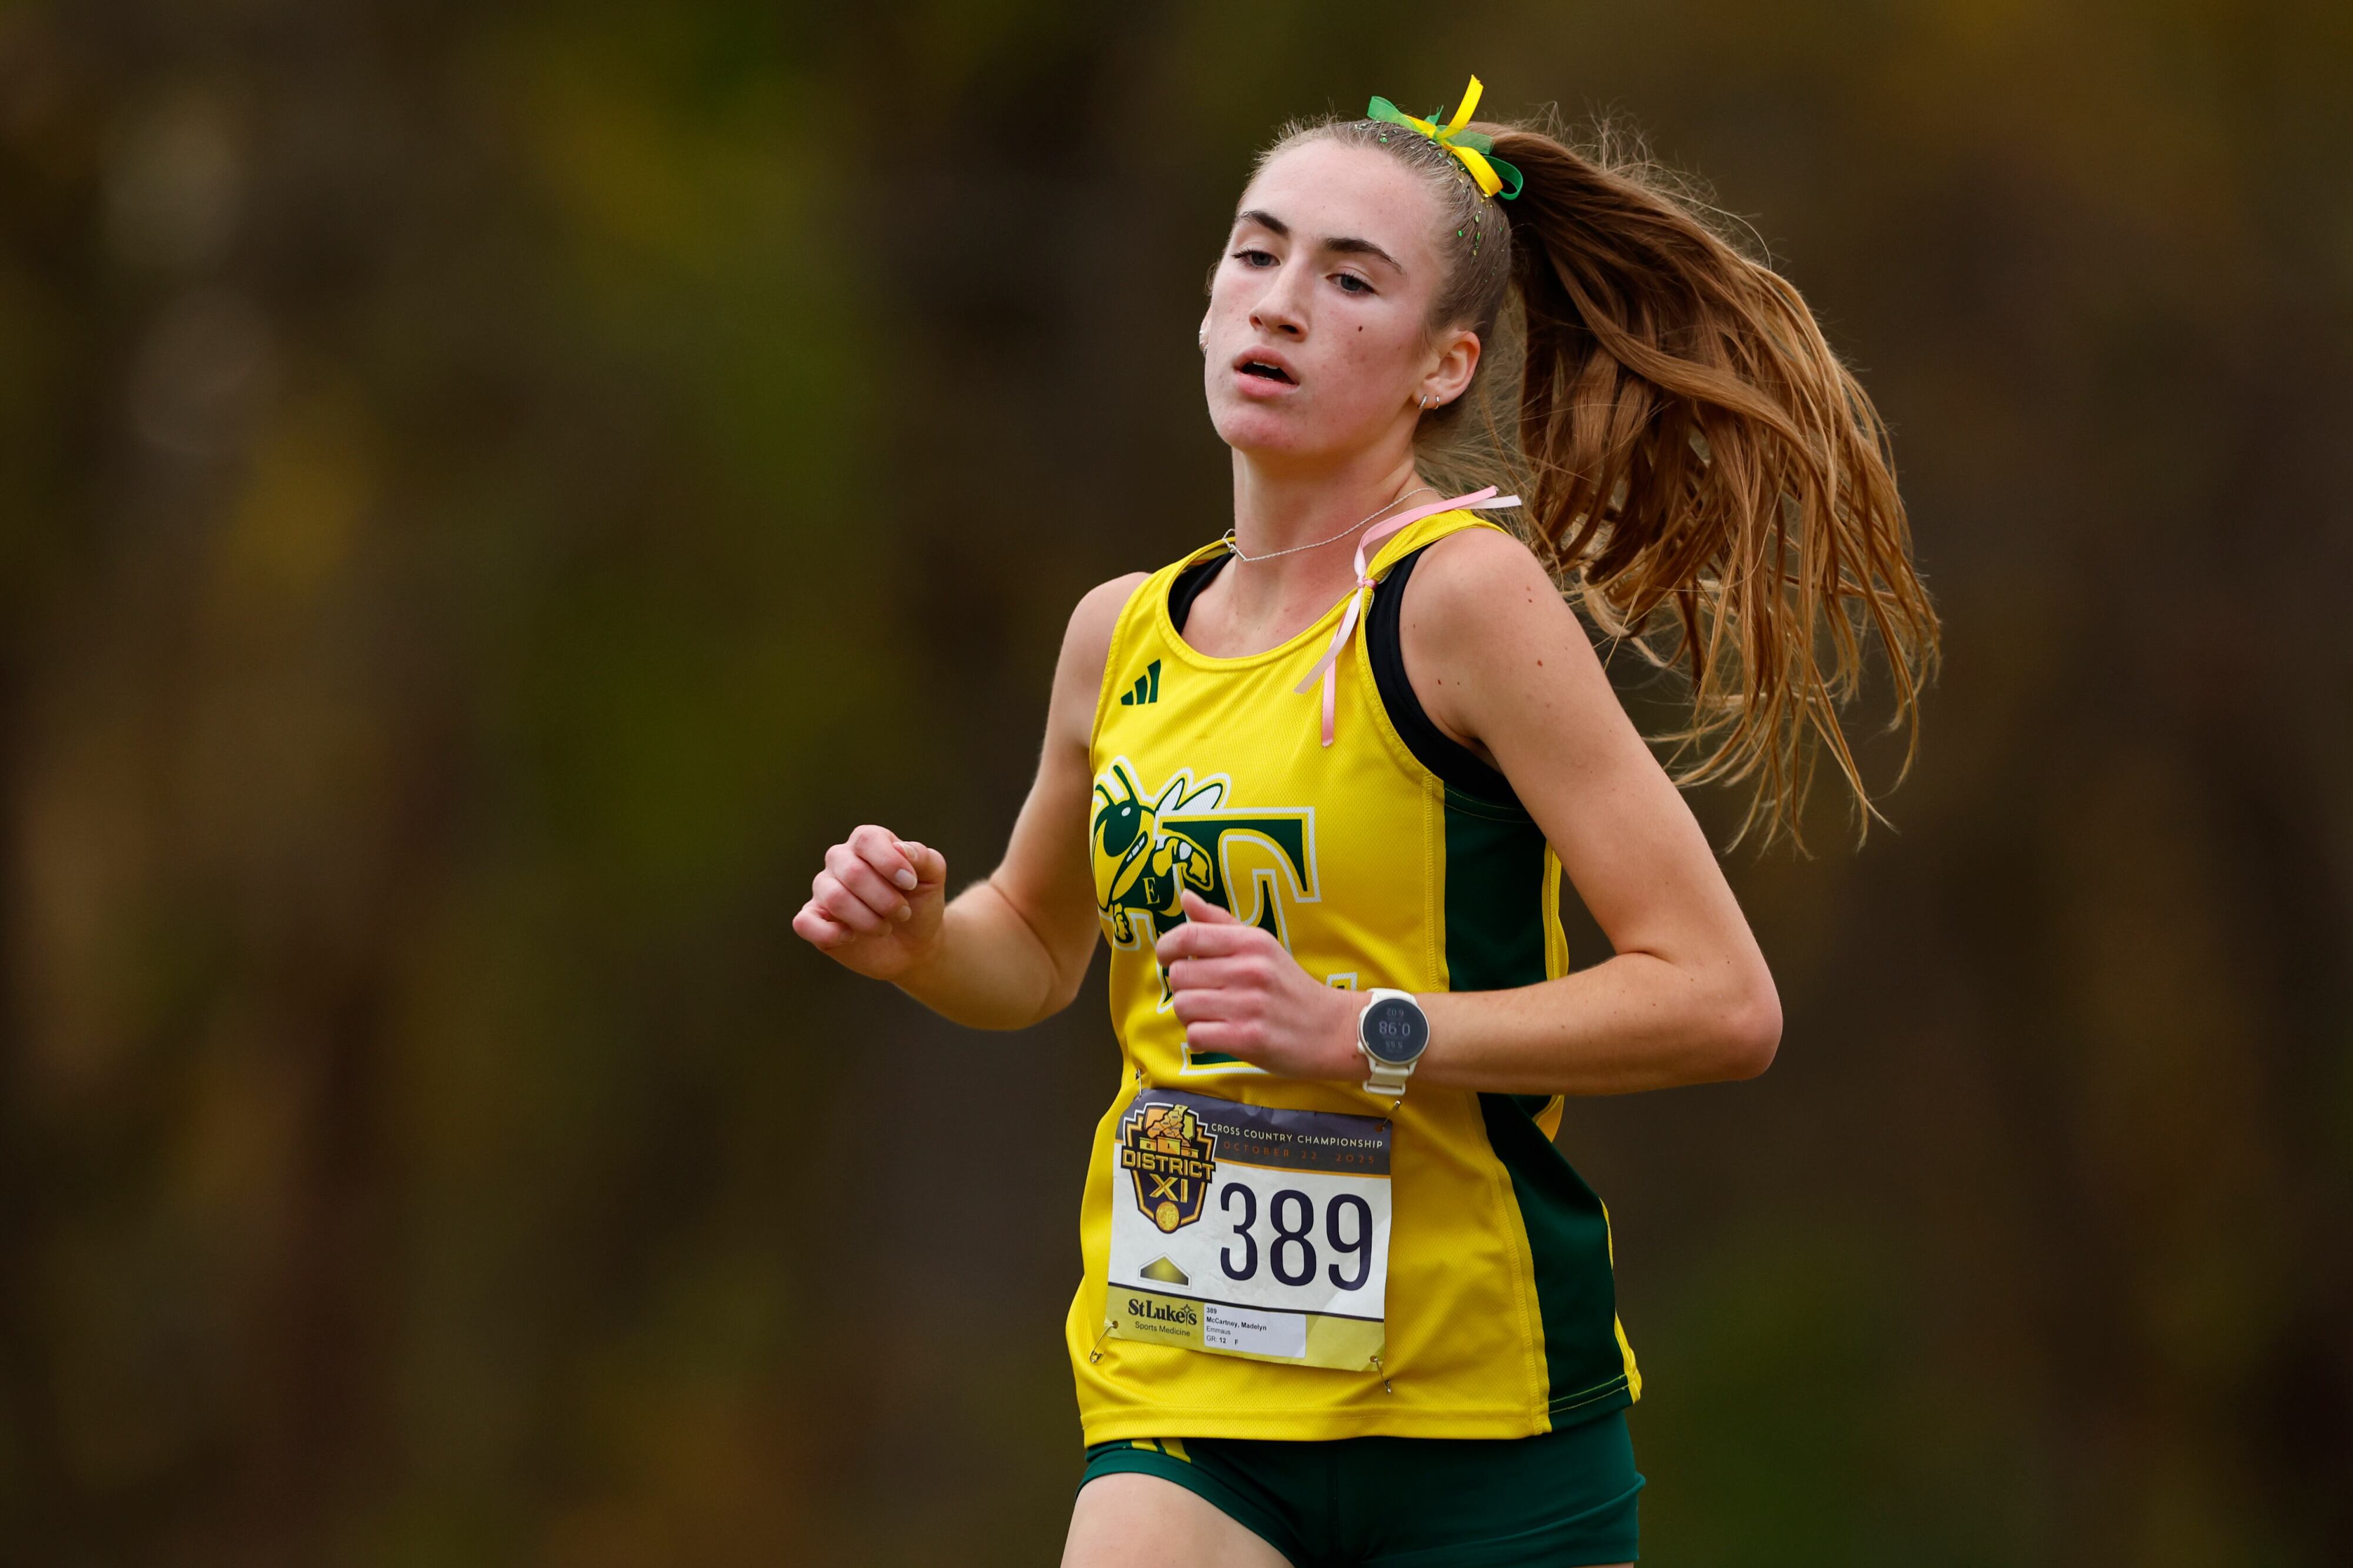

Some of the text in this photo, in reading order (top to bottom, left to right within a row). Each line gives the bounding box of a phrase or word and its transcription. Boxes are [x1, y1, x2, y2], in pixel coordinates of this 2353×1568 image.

[1142, 876, 1160, 905] E
[1211, 1123, 1383, 1149] CROSS COUNTRY CHAMPIONSHIP
[1122, 1149, 1214, 1180] DISTRICT
[1224, 1141, 1289, 1158] OCTOBER
[1336, 1153, 1375, 1164] 2025
[1149, 1173, 1188, 1203] XI
[1220, 1182, 1373, 1291] 389
[1135, 1321, 1191, 1337] Sports Medicine
[1207, 1316, 1267, 1332] McCartney, Madelyn
[1207, 1326, 1231, 1335] Emmaus
